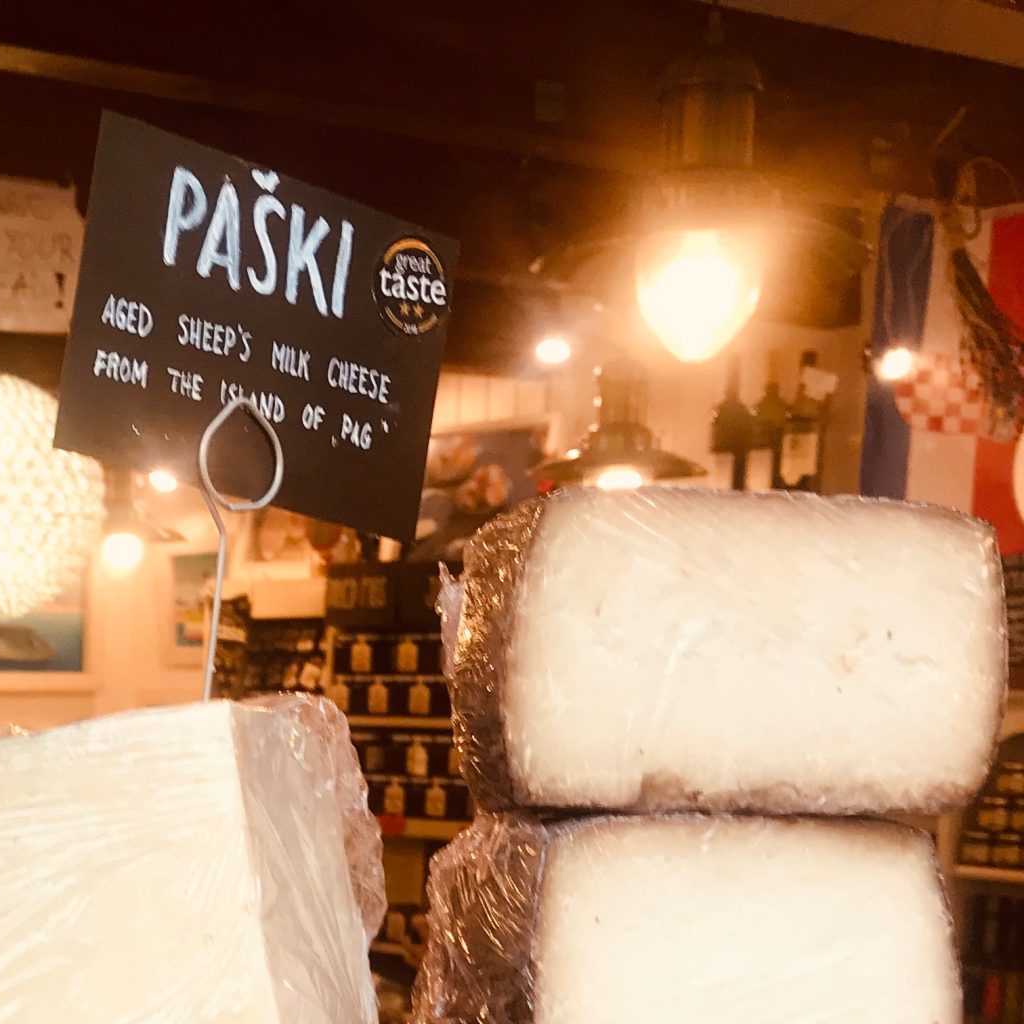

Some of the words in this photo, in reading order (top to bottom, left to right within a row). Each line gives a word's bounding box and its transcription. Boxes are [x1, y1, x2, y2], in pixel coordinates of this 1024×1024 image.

[162, 165, 355, 319] PAŠKI
[395, 253, 432, 275] great
[379, 267, 447, 306] taste
[93, 349, 149, 388] FROM
[166, 366, 204, 401] THE
[301, 403, 327, 431] OF
[102, 294, 154, 337] AGED
[178, 313, 252, 363] SHEEP'S
[272, 341, 311, 381] MILK
[327, 357, 392, 404] CHEESE
